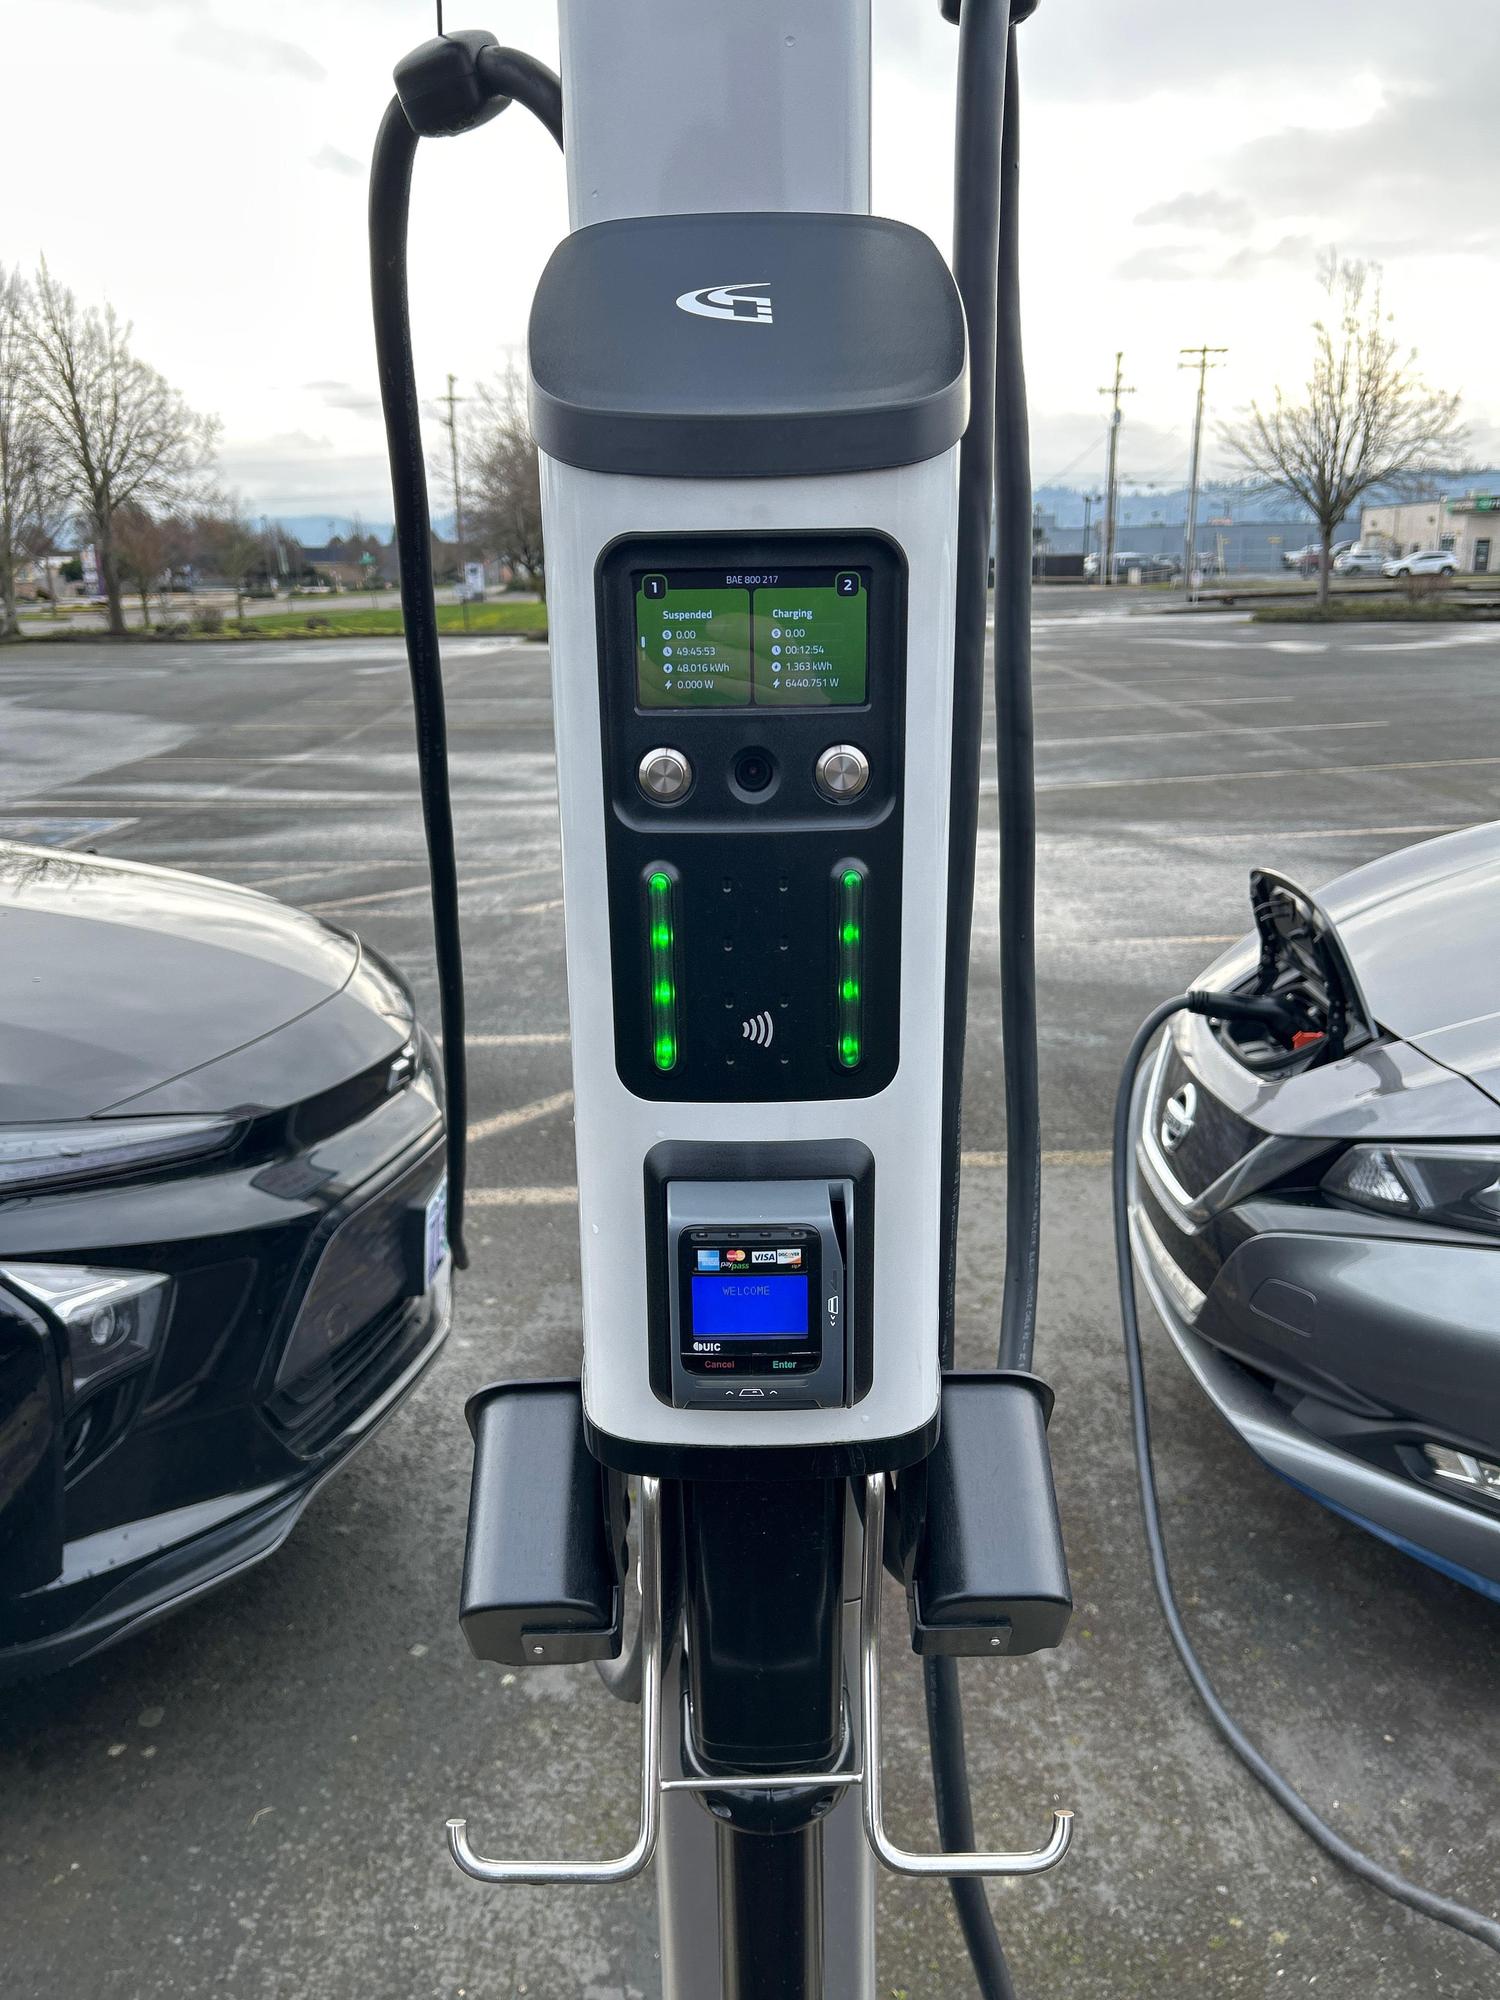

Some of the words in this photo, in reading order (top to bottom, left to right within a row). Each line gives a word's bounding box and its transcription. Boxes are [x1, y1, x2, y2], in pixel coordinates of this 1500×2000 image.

[726, 575, 743, 584] BAE
[744, 576, 761, 584] 800
[762, 576, 778, 584] 217
[651, 582, 658, 594] 1
[843, 579, 852, 591] 2
[662, 610, 712, 620] Suspended
[772, 609, 812, 620] Charging
[676, 630, 696, 639] 0.00
[785, 629, 806, 638] 0.00
[676, 646, 716, 656] 49:45:53
[785, 646, 824, 654] 00:12:54
[676, 664, 708, 672] 48.016
[710, 662, 730, 672] kWh
[786, 662, 811, 671] 1.363
[812, 661, 832, 670] kWh
[677, 680, 703, 688] 0.000
[704, 680, 714, 688] W
[785, 678, 828, 688] 6440.751
[829, 678, 839, 687] W
[754, 1253, 775, 1262] VISA
[722, 1286, 770, 1296] WELCOME
[704, 1361, 735, 1369] Cancel
[772, 1360, 798, 1369] Enter
